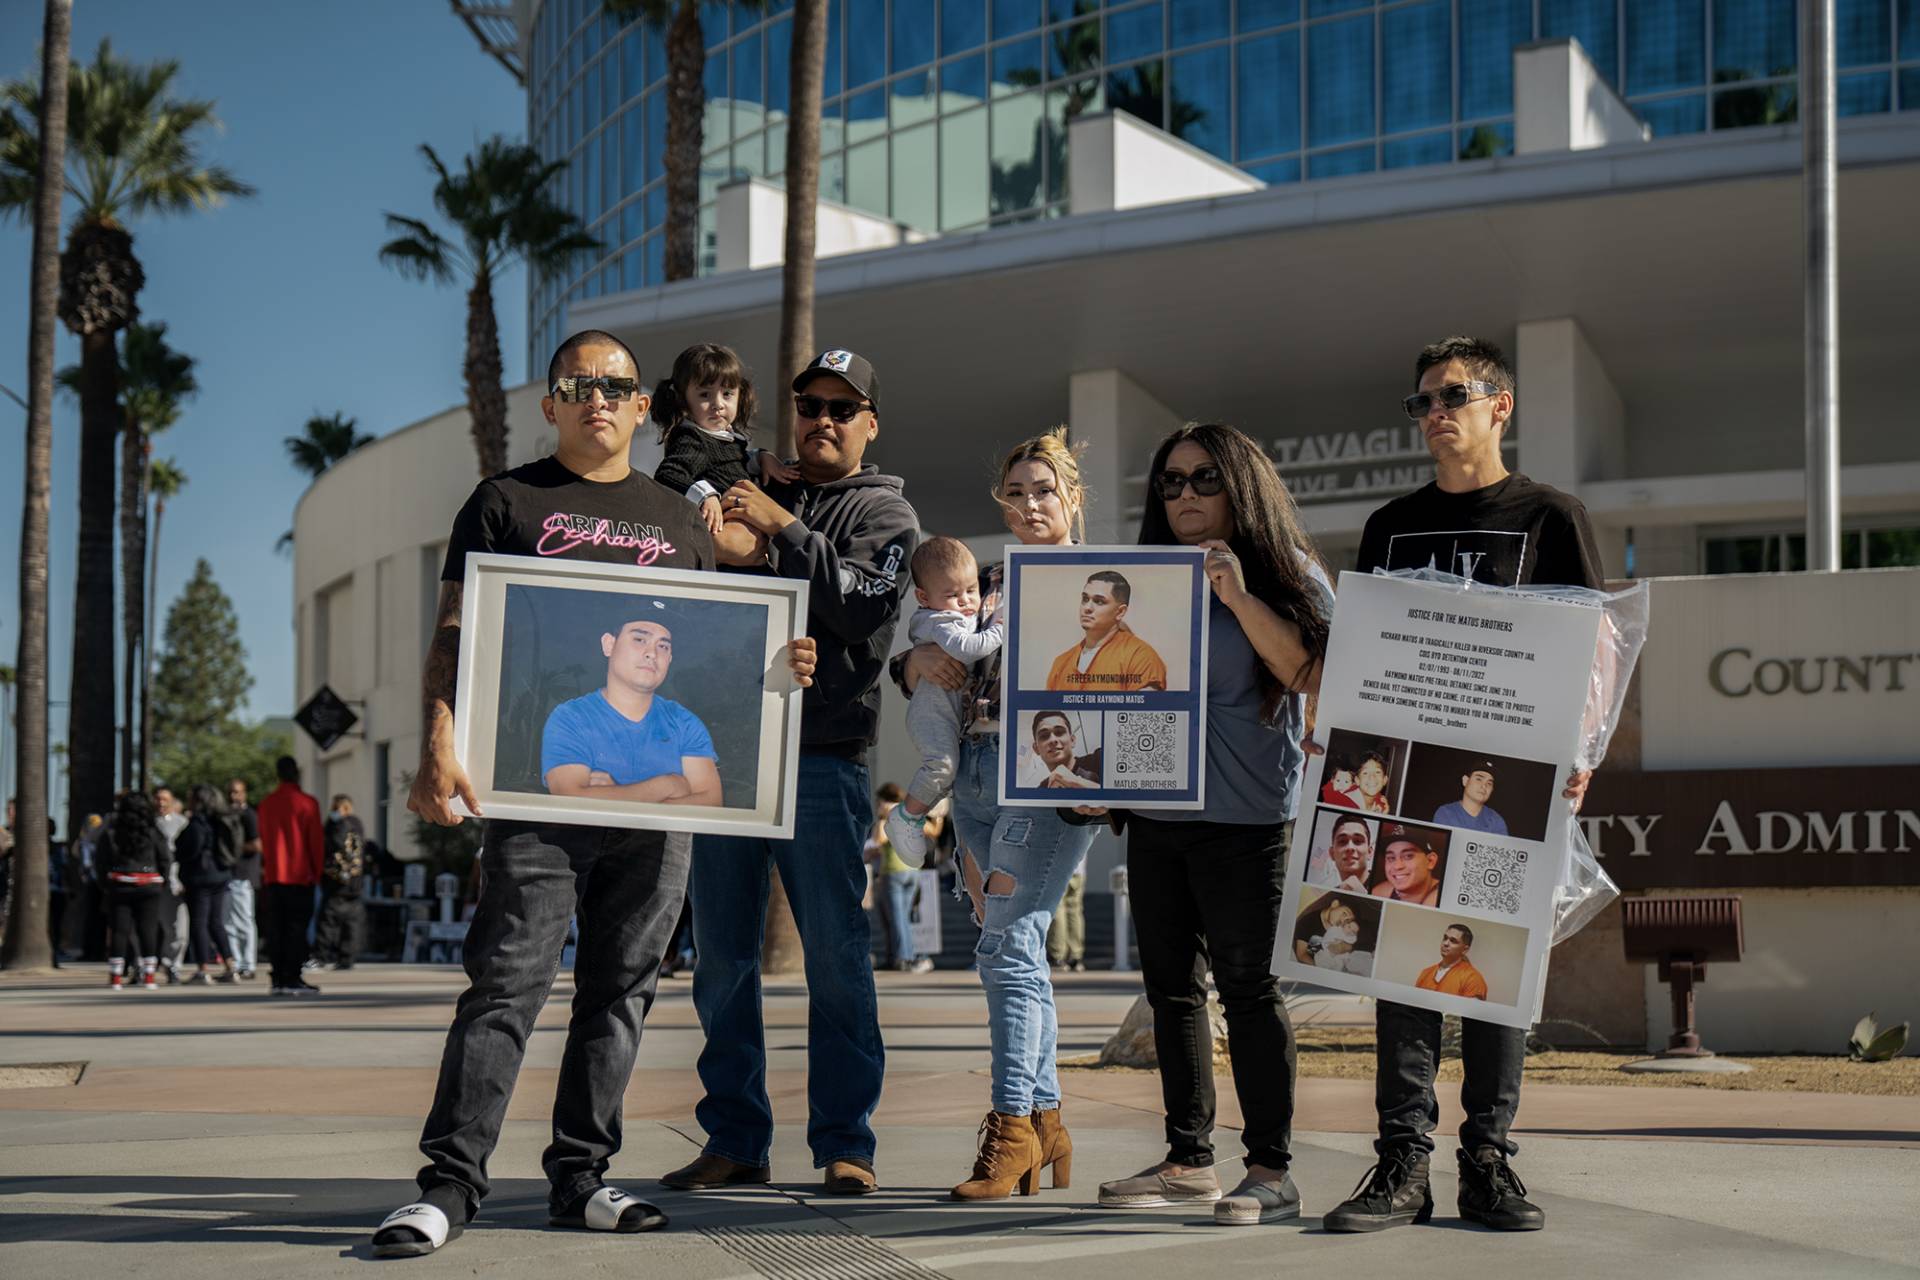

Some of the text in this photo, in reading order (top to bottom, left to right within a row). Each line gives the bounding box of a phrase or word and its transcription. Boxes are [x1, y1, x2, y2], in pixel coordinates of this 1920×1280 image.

[1274, 425, 1431, 464] TAVAGLI
[1352, 466, 1436, 489] ANNE
[536, 512, 676, 566] Exchange
[551, 512, 665, 544] ARMANI
[1408, 608, 1513, 632] JUSTICE FOR THE MATUS BROTHERS
[1380, 631, 1401, 641] RICHARD
[1402, 634, 1418, 644] MATUS
[1425, 637, 1454, 648] TRAGICALLY
[1454, 641, 1471, 651] KILLED
[1478, 645, 1503, 656] RIVERSIDE
[1504, 649, 1524, 659] COUNTY
[1442, 653, 1468, 664] DETENTION
[1469, 657, 1487, 667] CENTER
[1708, 648, 1920, 698] COUNT
[1067, 674, 1142, 684] #FREERAYMONDMATUS
[1385, 670, 1407, 680] RAYMOND
[1408, 674, 1424, 683] MATUS
[1450, 680, 1472, 690] DETAINEE
[1474, 684, 1488, 693] SINCE
[1489, 686, 1501, 695] JUNE
[1063, 695, 1144, 704] JUSTICE FOR RAYMOND MATUS
[1359, 692, 1381, 701] YOURSELF
[1382, 695, 1395, 704] WHEN
[1396, 698, 1418, 708] SOMEONE
[1425, 702, 1442, 711] TRYING
[1450, 706, 1470, 716] MURDER
[1472, 710, 1481, 718] YOU
[1491, 712, 1504, 721] YOUR
[1505, 715, 1521, 724] LOVED
[1363, 680, 1379, 689] DENIED
[1392, 684, 1400, 692] YET
[1401, 685, 1427, 696] CONVICTED
[1488, 699, 1504, 709] CRIME
[1505, 701, 1512, 710] TO
[1513, 703, 1535, 713] PROTECT
